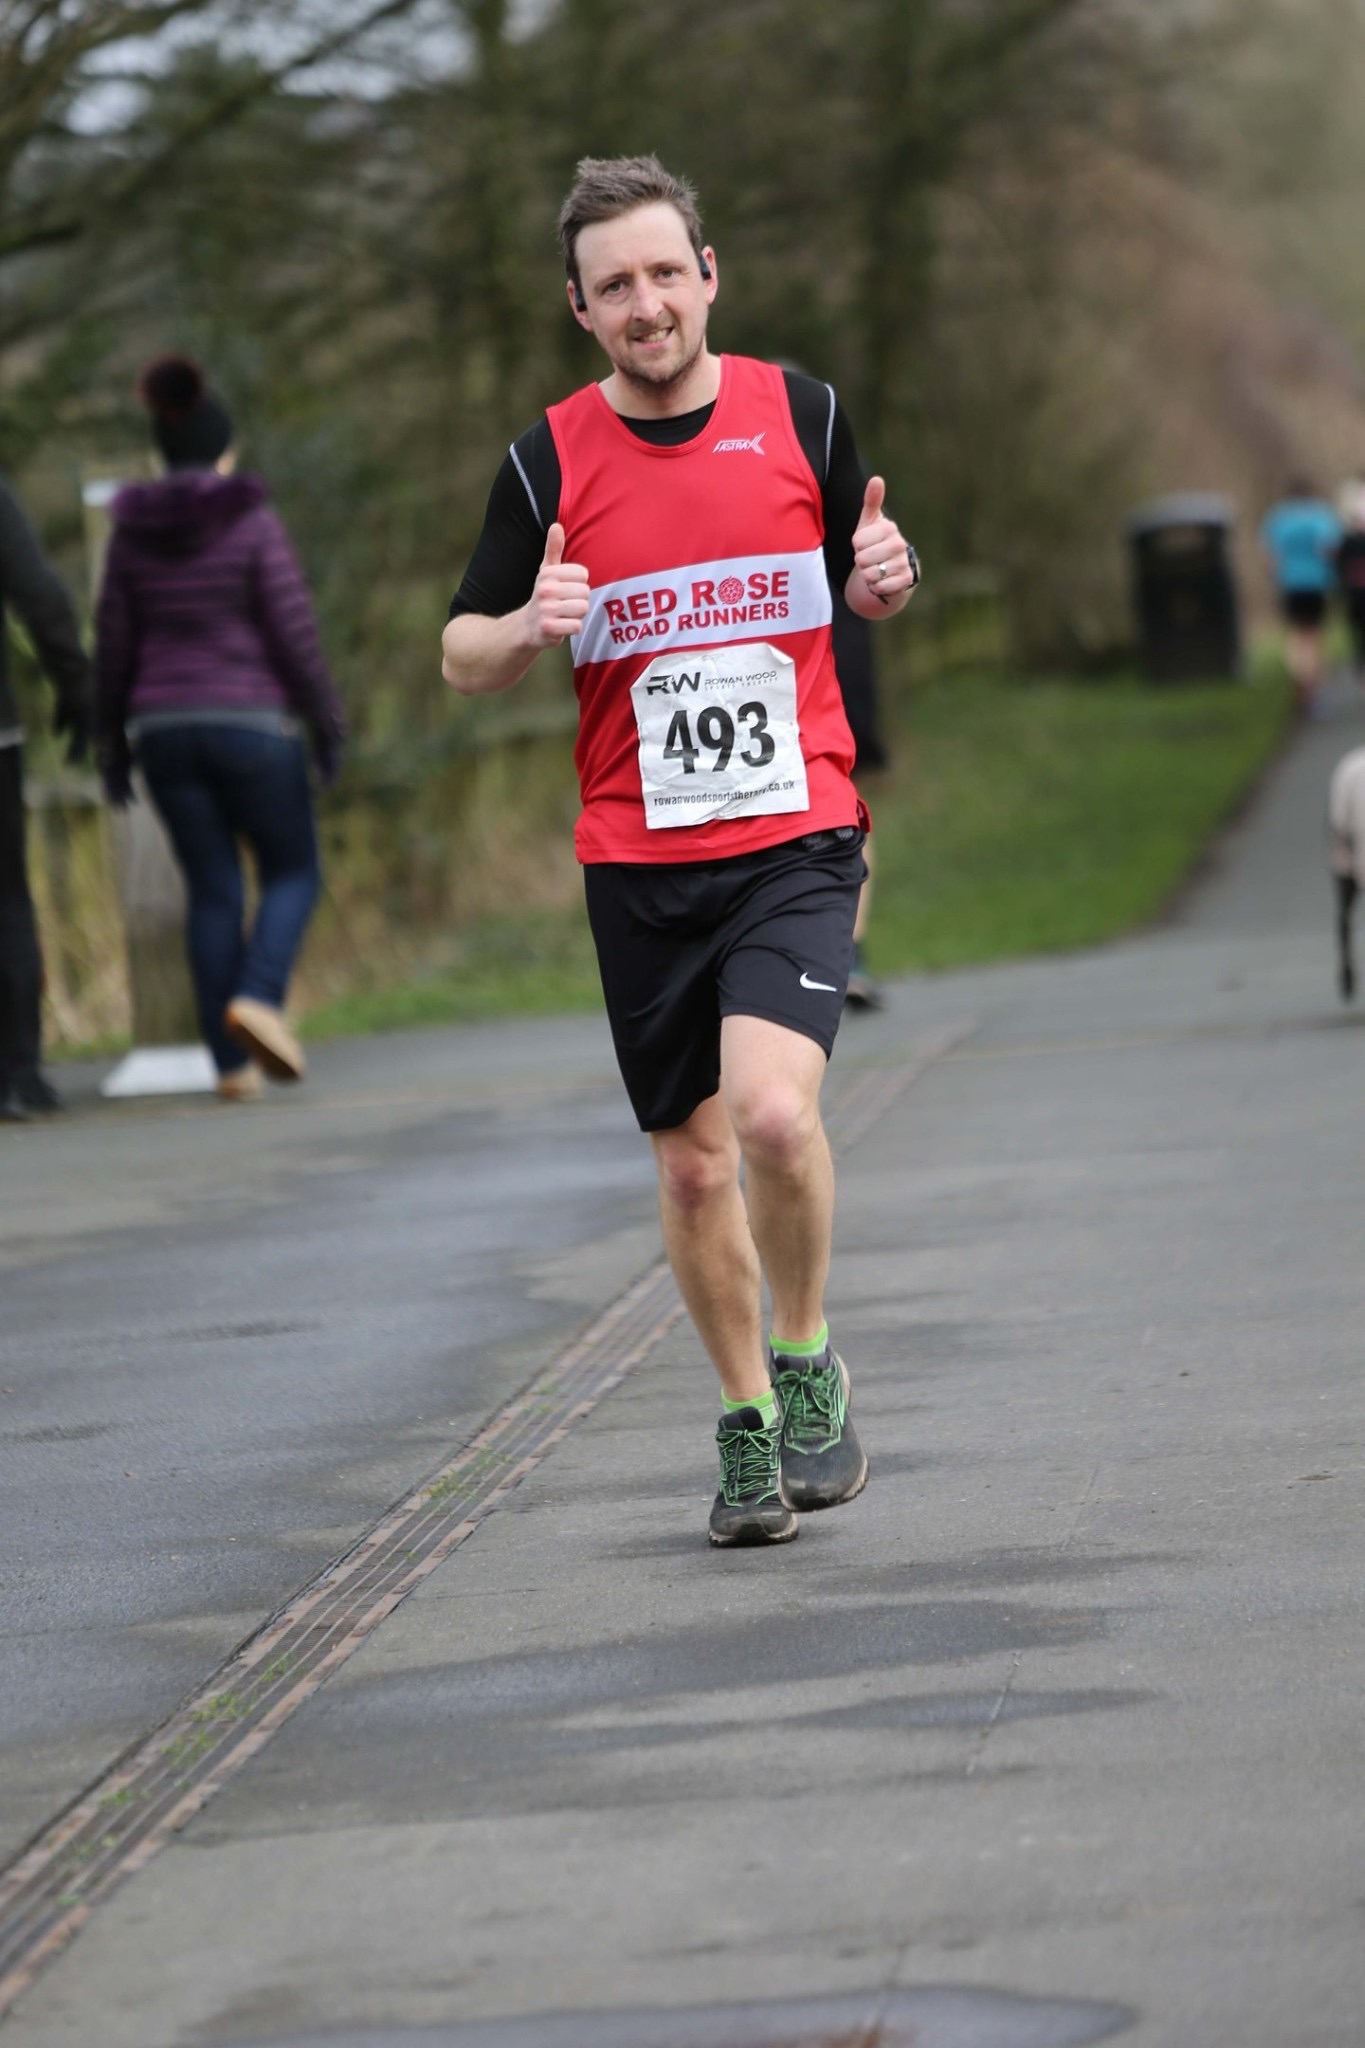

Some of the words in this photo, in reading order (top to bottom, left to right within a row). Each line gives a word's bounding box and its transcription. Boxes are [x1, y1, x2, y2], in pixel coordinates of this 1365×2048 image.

[604, 588, 677, 626] RED
[691, 571, 790, 609] ROSE
[609, 622, 670, 645] ROAD
[677, 601, 790, 632] RUNNERS
[704, 676, 742, 686] ROWAN
[746, 670, 777, 681] WOOD
[663, 701, 775, 774] 493
